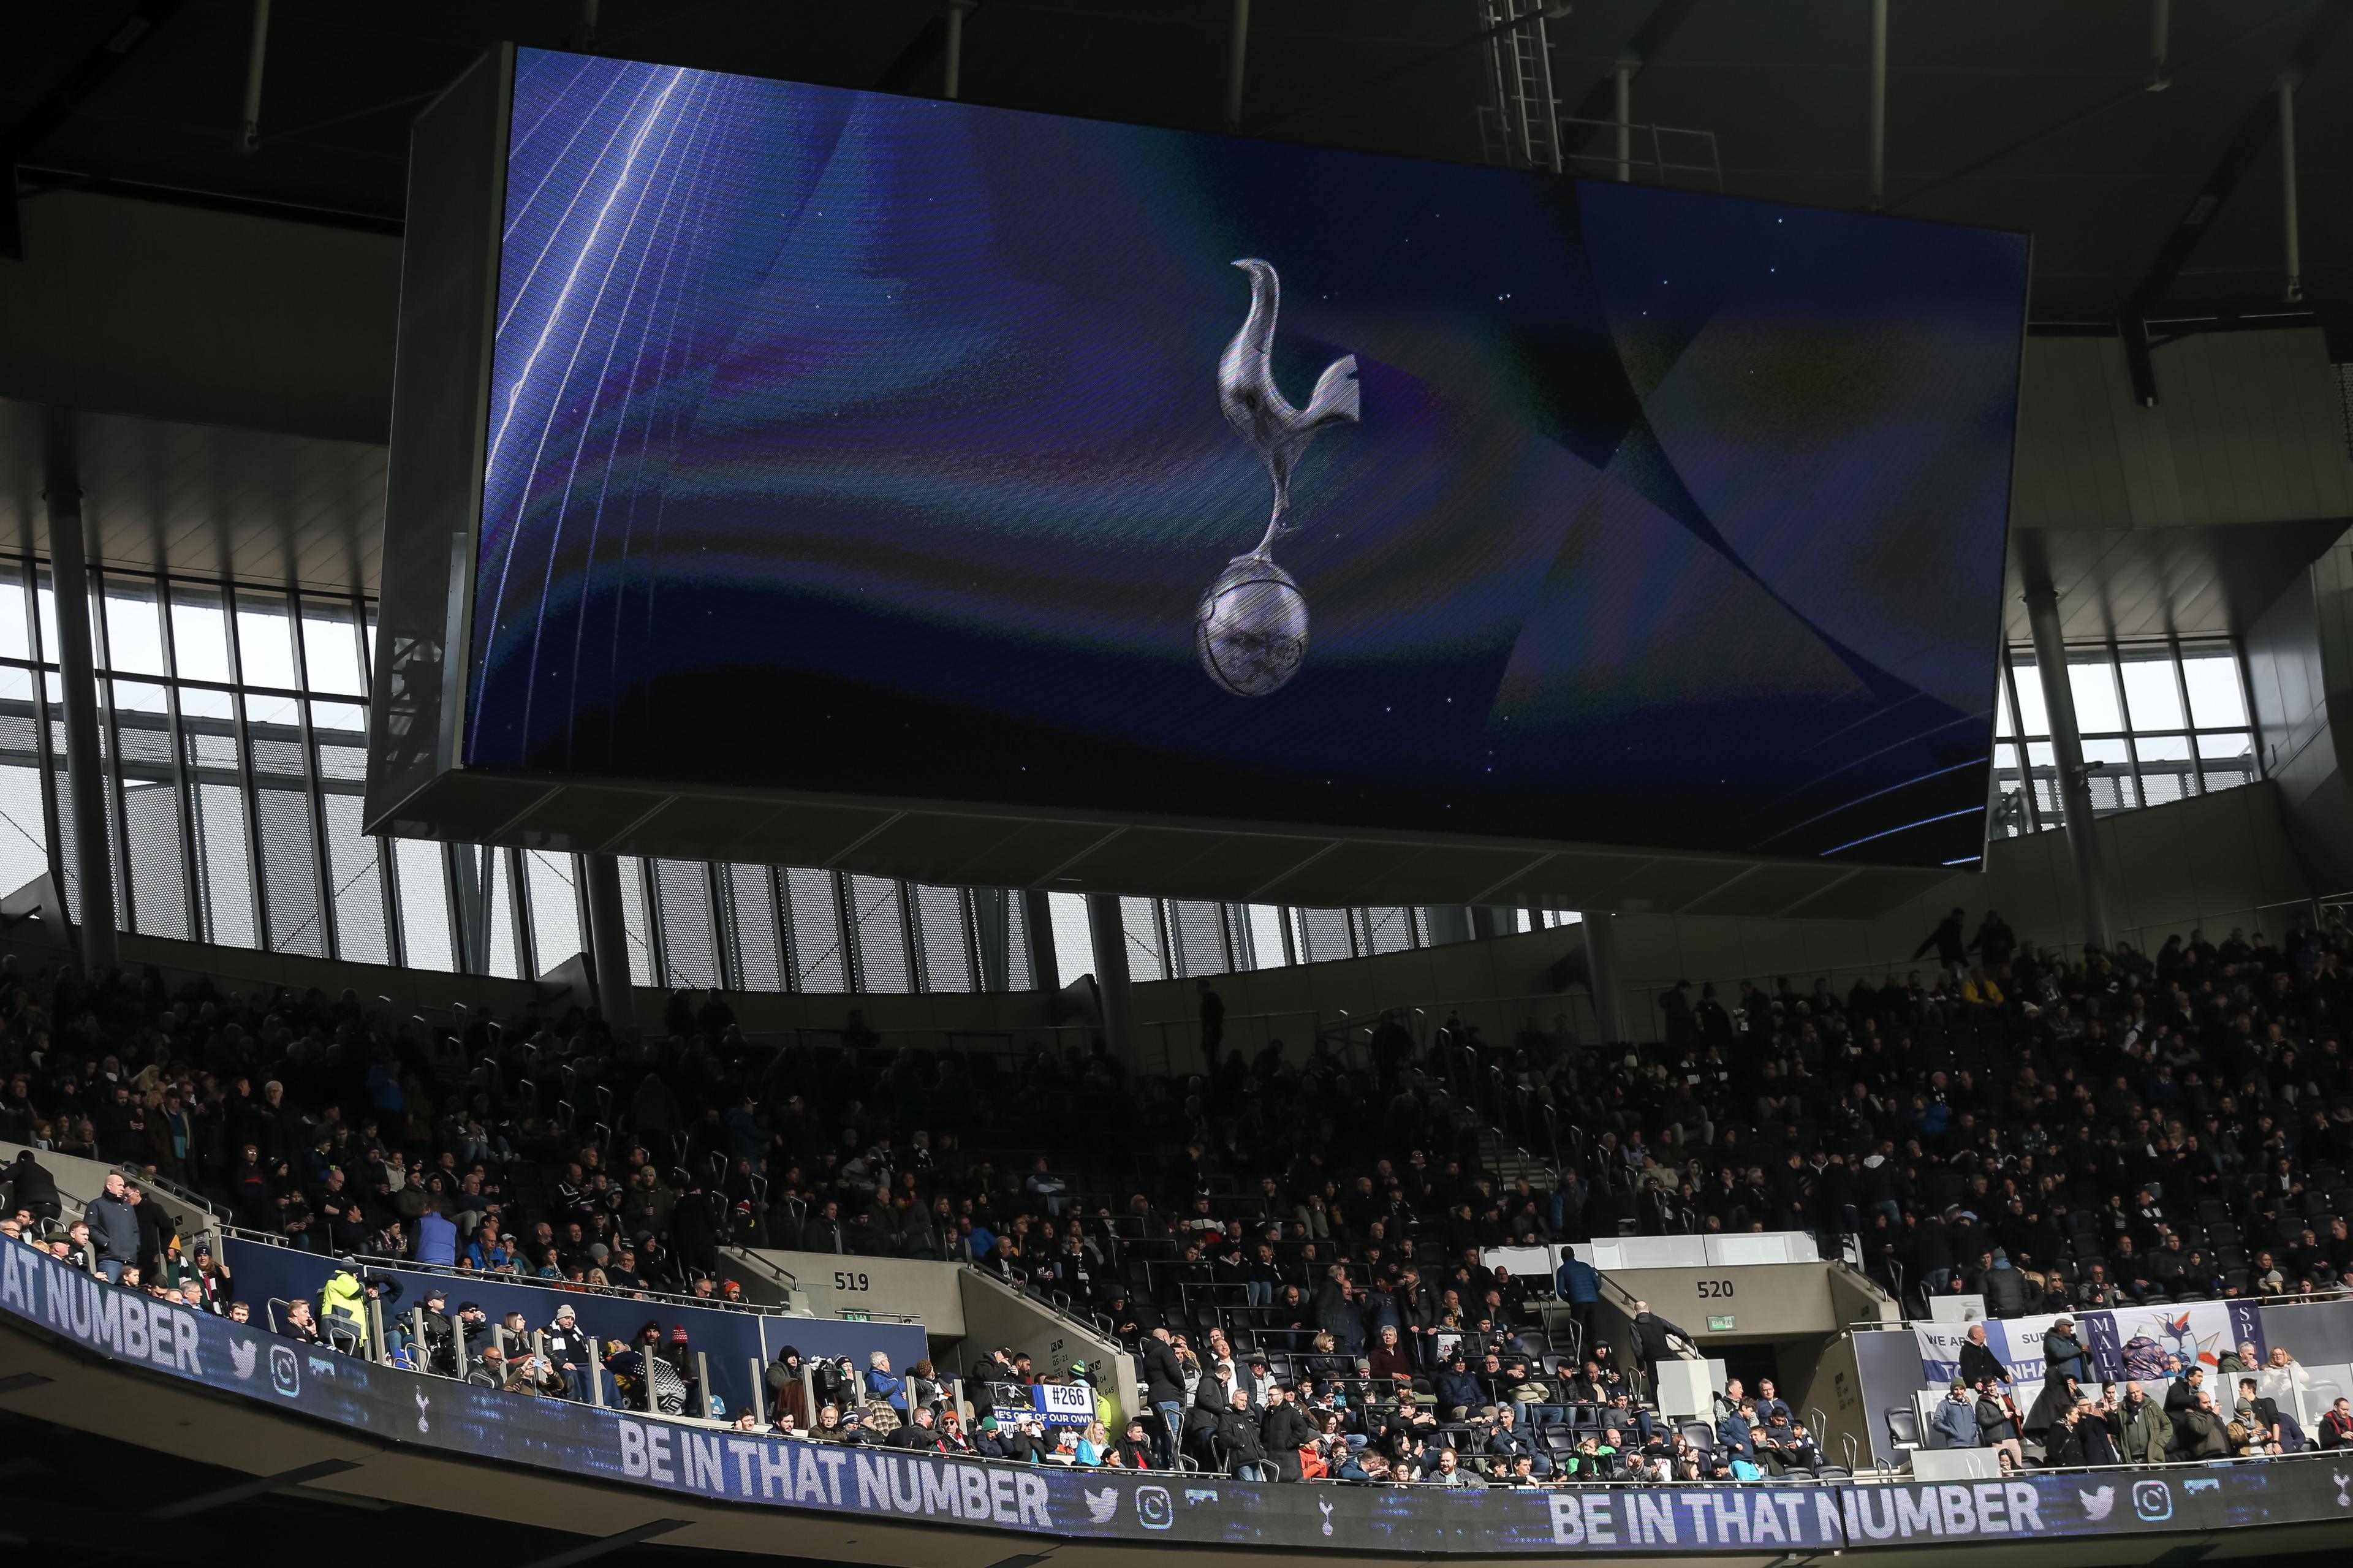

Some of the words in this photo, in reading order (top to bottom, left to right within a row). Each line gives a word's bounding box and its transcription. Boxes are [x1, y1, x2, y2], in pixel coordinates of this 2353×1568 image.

[834, 1271, 869, 1292] 519
[1697, 1280, 1733, 1298] 520
[45, 1260, 203, 1376] NUMBER
[2239, 1307, 2256, 1341] SP
[1926, 1334, 1946, 1346] WE
[1950, 1336, 1965, 1347] AR
[2092, 1317, 2118, 1380] MALT
[1052, 1387, 1085, 1406] #266
[995, 1411, 1012, 1419] HE'S
[1034, 1413, 1047, 1422] OF
[618, 1419, 675, 1483] BE
[680, 1431, 725, 1493] IN
[727, 1439, 846, 1506] THAT
[855, 1453, 1053, 1528] NUMBER
[1548, 1493, 1617, 1545] BE
[1623, 1493, 1678, 1545] IN
[1681, 1492, 1806, 1544] THAT
[1814, 1482, 2045, 1542] NUMBER
